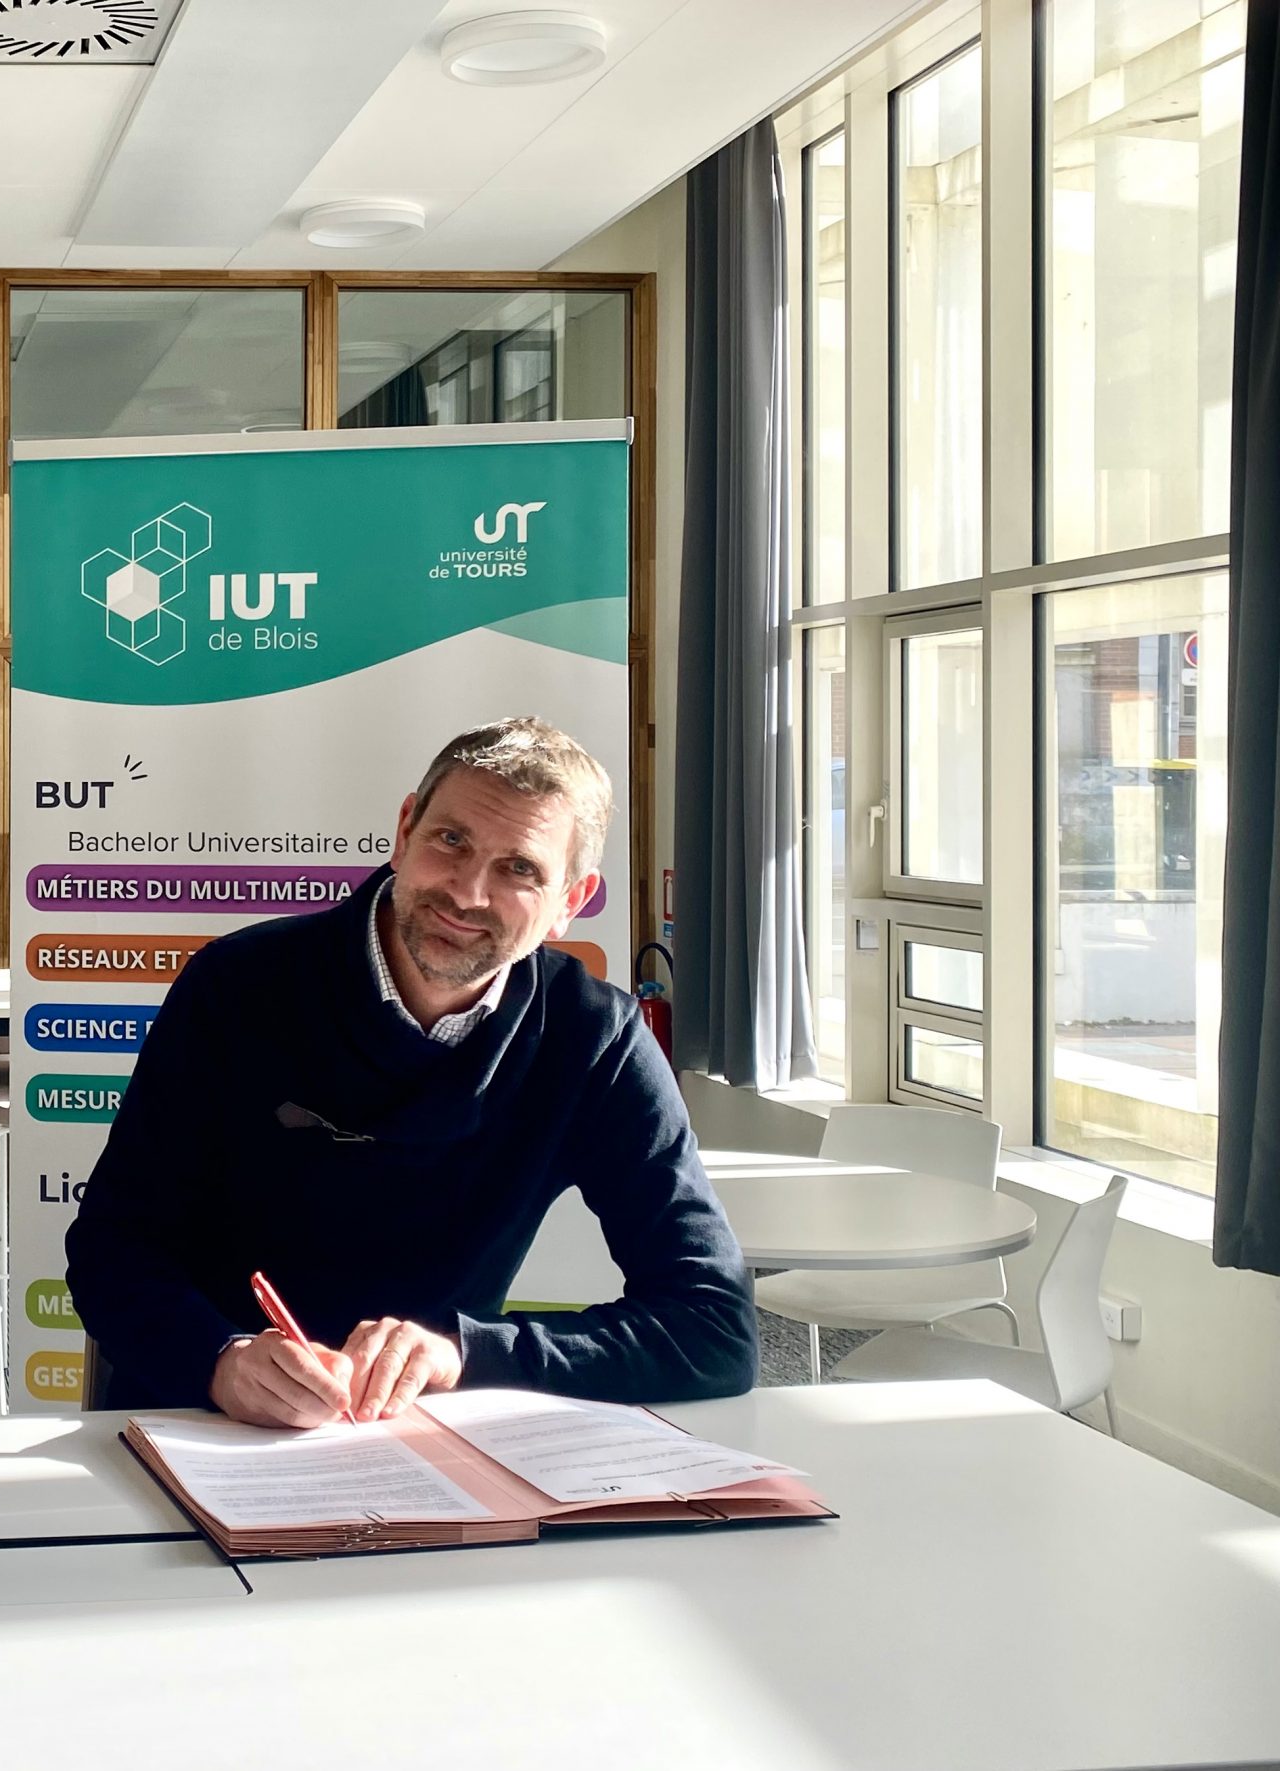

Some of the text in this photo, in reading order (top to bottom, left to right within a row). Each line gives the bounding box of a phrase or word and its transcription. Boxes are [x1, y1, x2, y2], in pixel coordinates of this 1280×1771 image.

[440, 546, 527, 562] université
[429, 562, 527, 578] de TOURS
[209, 572, 318, 620] IUT
[208, 625, 318, 651] de Blois
[35, 781, 114, 809] BUT
[69, 831, 391, 854] Bachelor Universitaire de
[37, 874, 353, 902] MÉTIERS DU MULTIMÉDIA
[38, 944, 182, 970] RÉSEAUX ET
[37, 1018, 138, 1040] SCIENCE
[37, 1088, 122, 1110] MESUR
